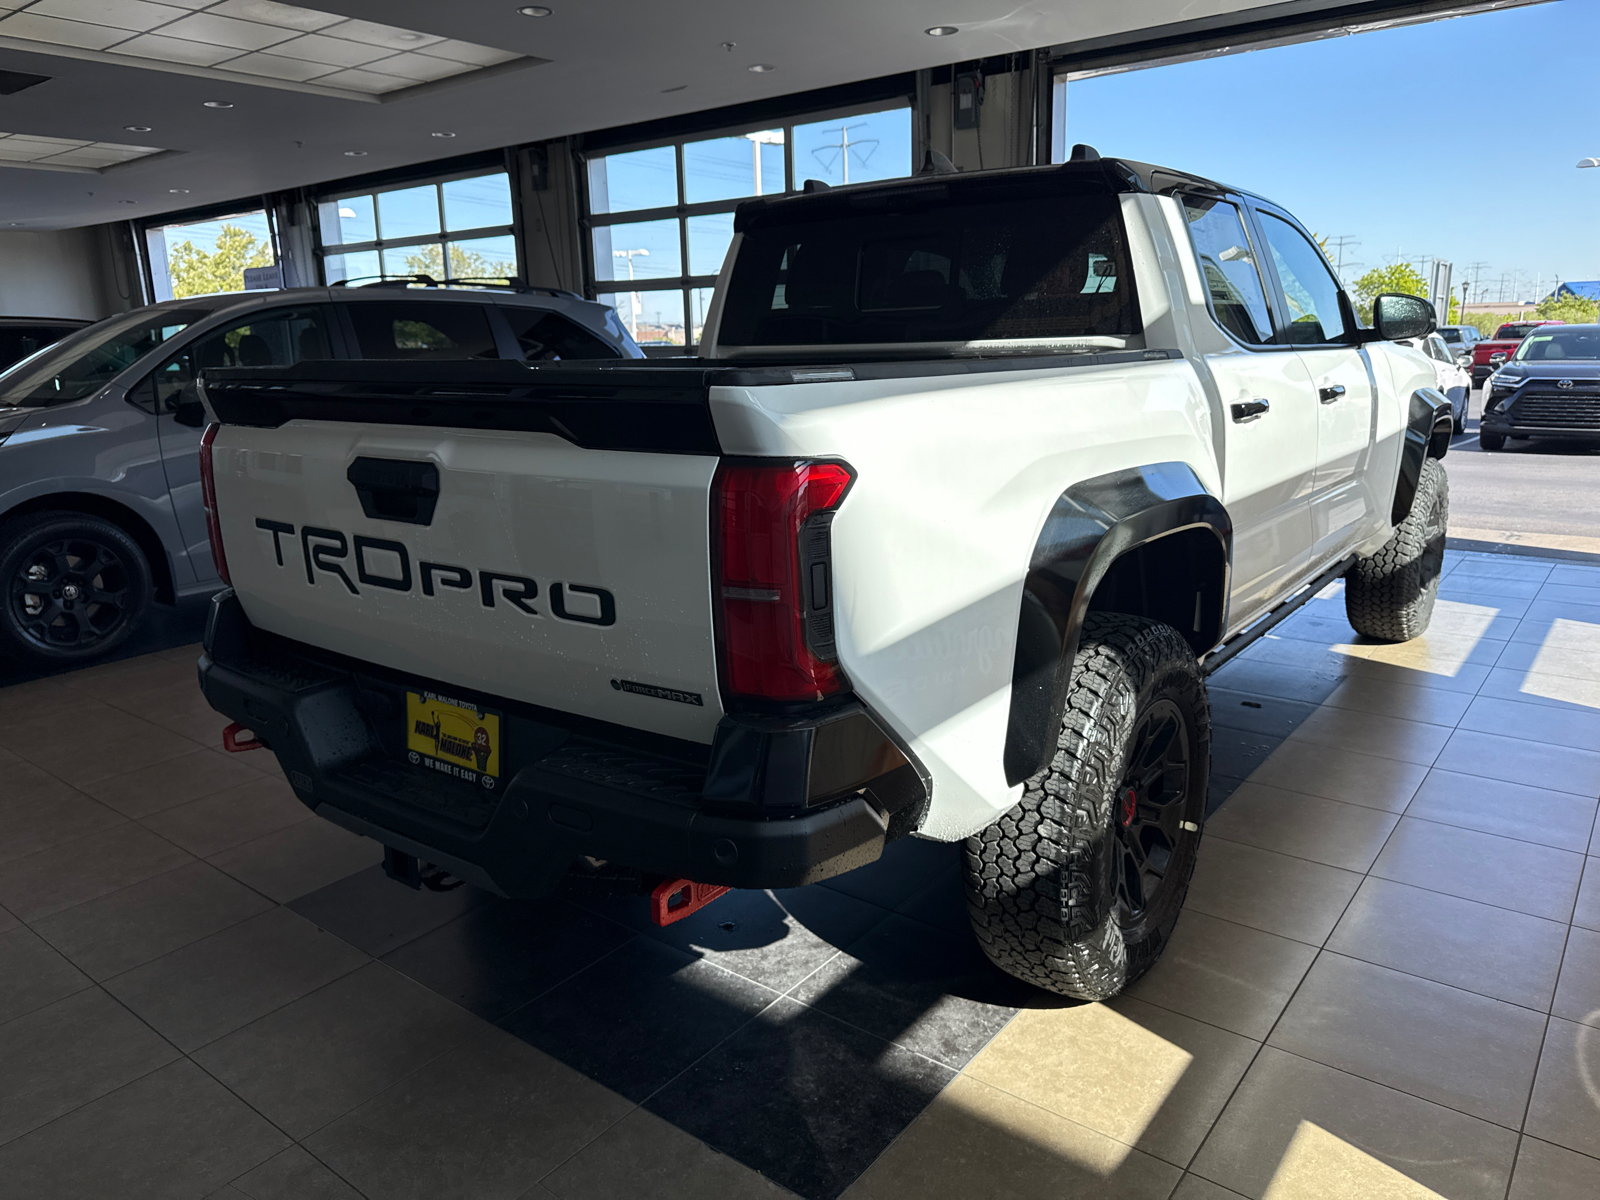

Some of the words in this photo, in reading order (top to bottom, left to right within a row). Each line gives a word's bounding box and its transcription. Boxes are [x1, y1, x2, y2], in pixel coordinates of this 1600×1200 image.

[424, 691, 437, 701] KARL
[438, 695, 458, 706] MALONE
[458, 700, 478, 712] TOYOTA
[414, 720, 436, 739] KARL
[476, 733, 487, 746] 32
[440, 738, 472, 761] MALONE
[424, 757, 434, 769] WE
[435, 760, 452, 774] MAKE
[453, 766, 460, 776] IT
[460, 769, 477, 783] EASY
